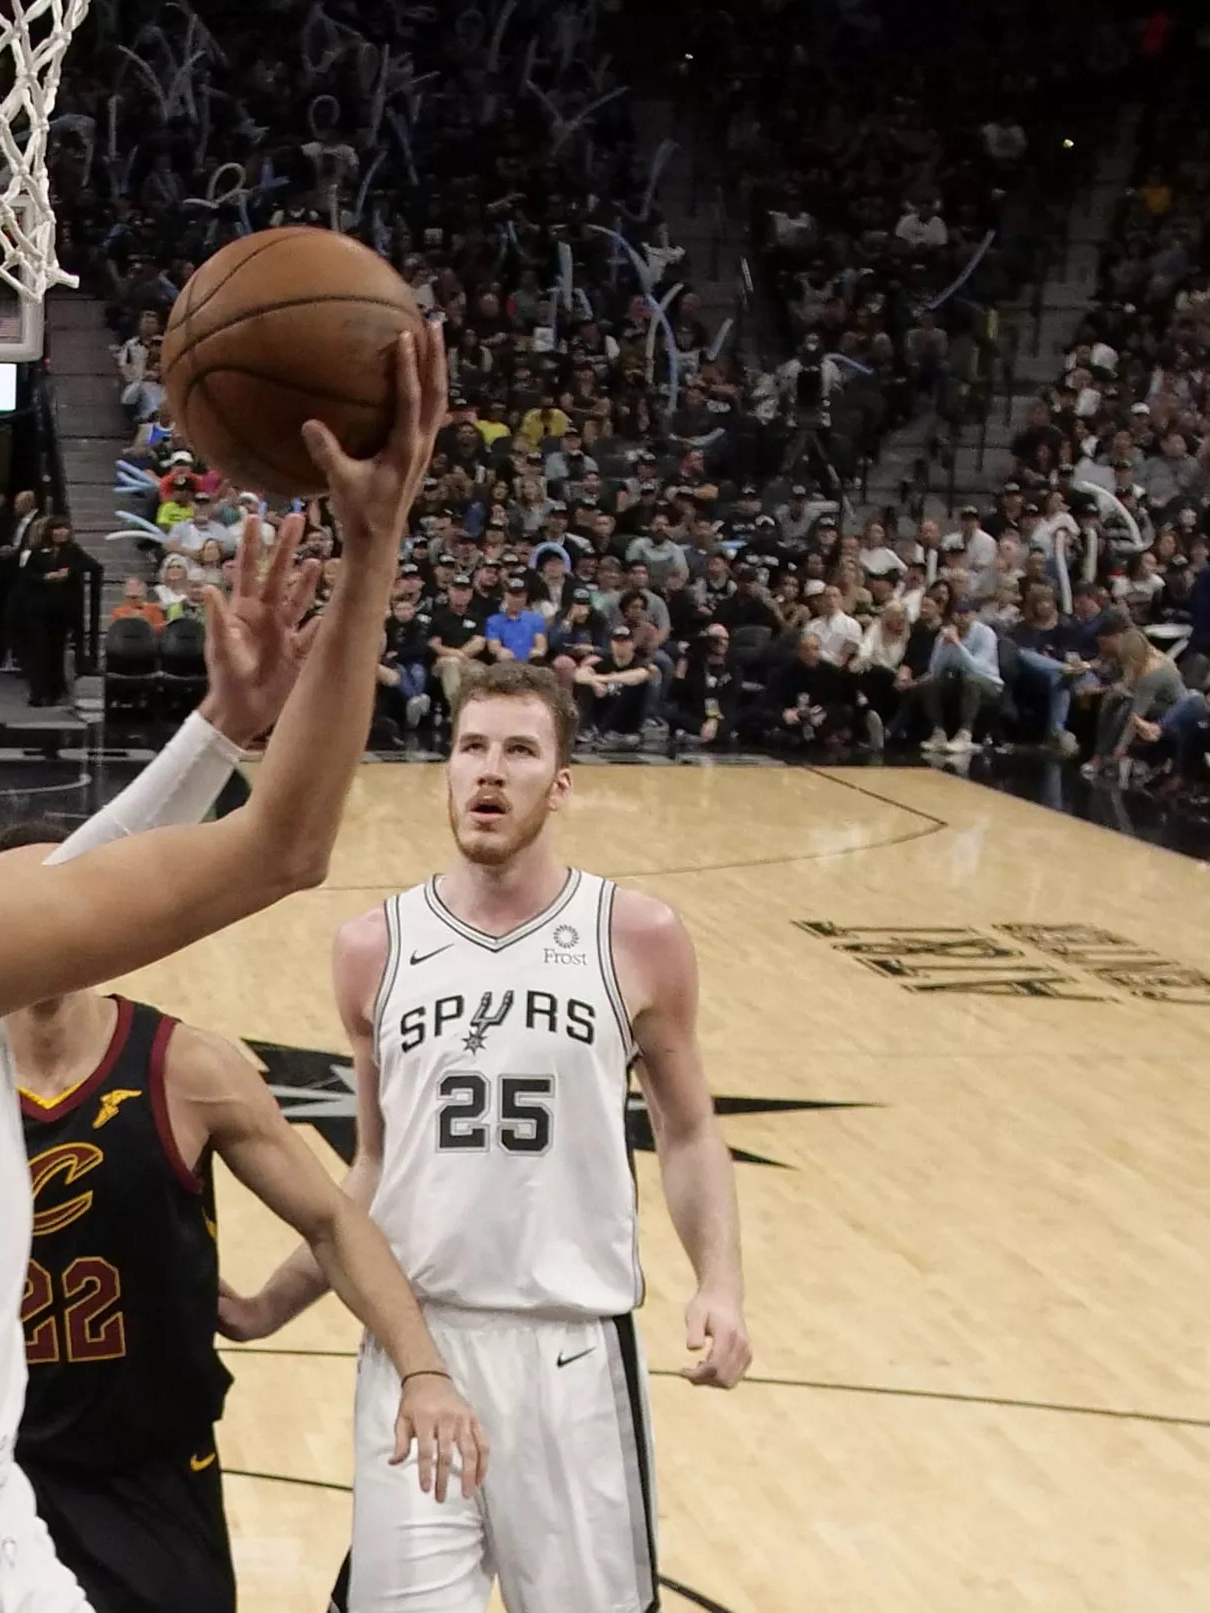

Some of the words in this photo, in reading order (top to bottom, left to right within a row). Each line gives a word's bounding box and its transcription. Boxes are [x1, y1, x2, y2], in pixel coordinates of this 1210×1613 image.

[542, 947, 588, 966] Frost
[399, 989, 597, 1055] SPURS
[435, 1069, 556, 1157] 25
[21, 1256, 127, 1363] 22
